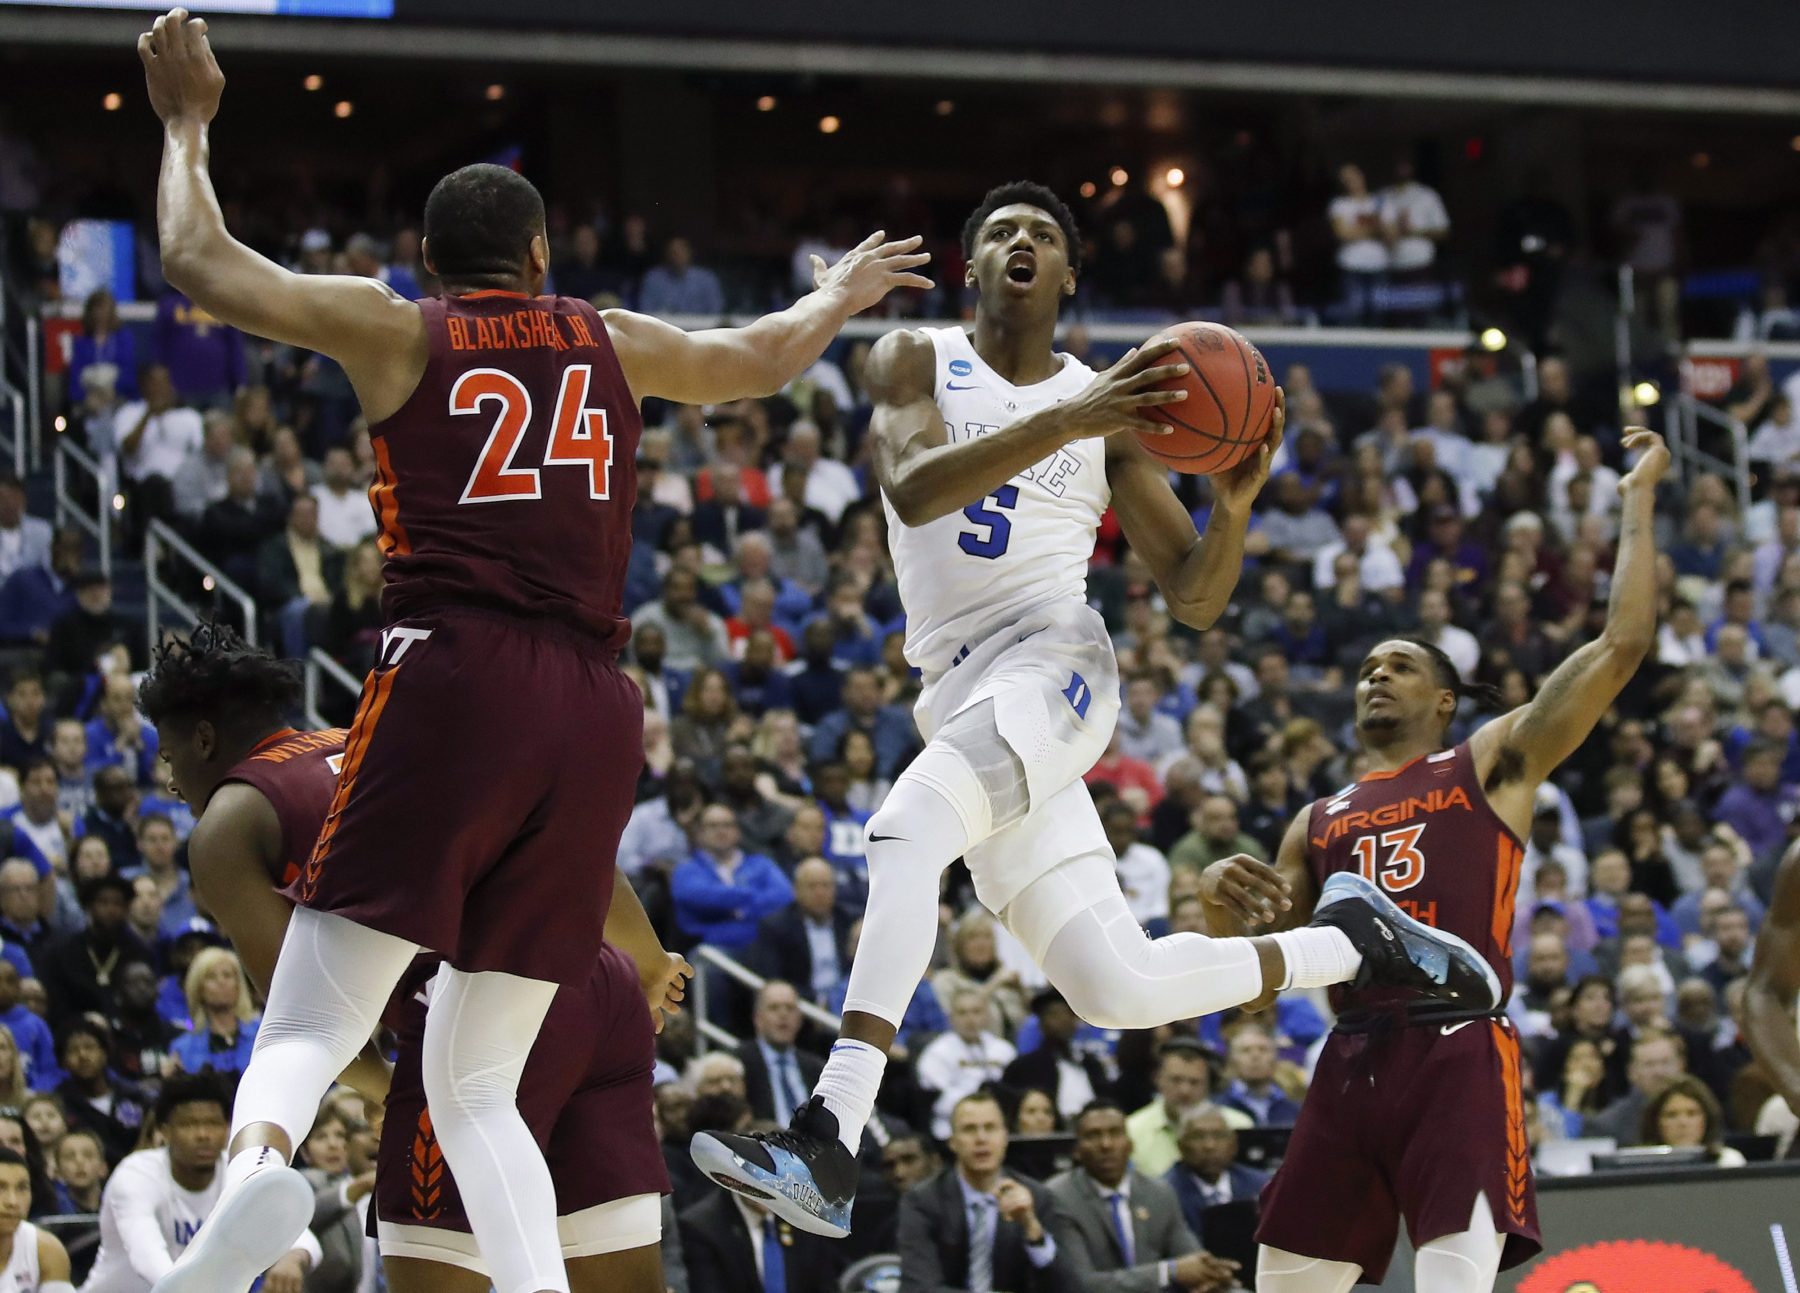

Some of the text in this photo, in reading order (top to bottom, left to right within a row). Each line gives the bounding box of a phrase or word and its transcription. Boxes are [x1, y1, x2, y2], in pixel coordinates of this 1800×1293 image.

[449, 364, 613, 504] 24
[958, 484, 1020, 560] 5
[249, 728, 350, 763] WILKIN
[1312, 786, 1473, 849] VIRGINIA
[1351, 823, 1427, 892] 13
[793, 1183, 823, 1214] DUKE
